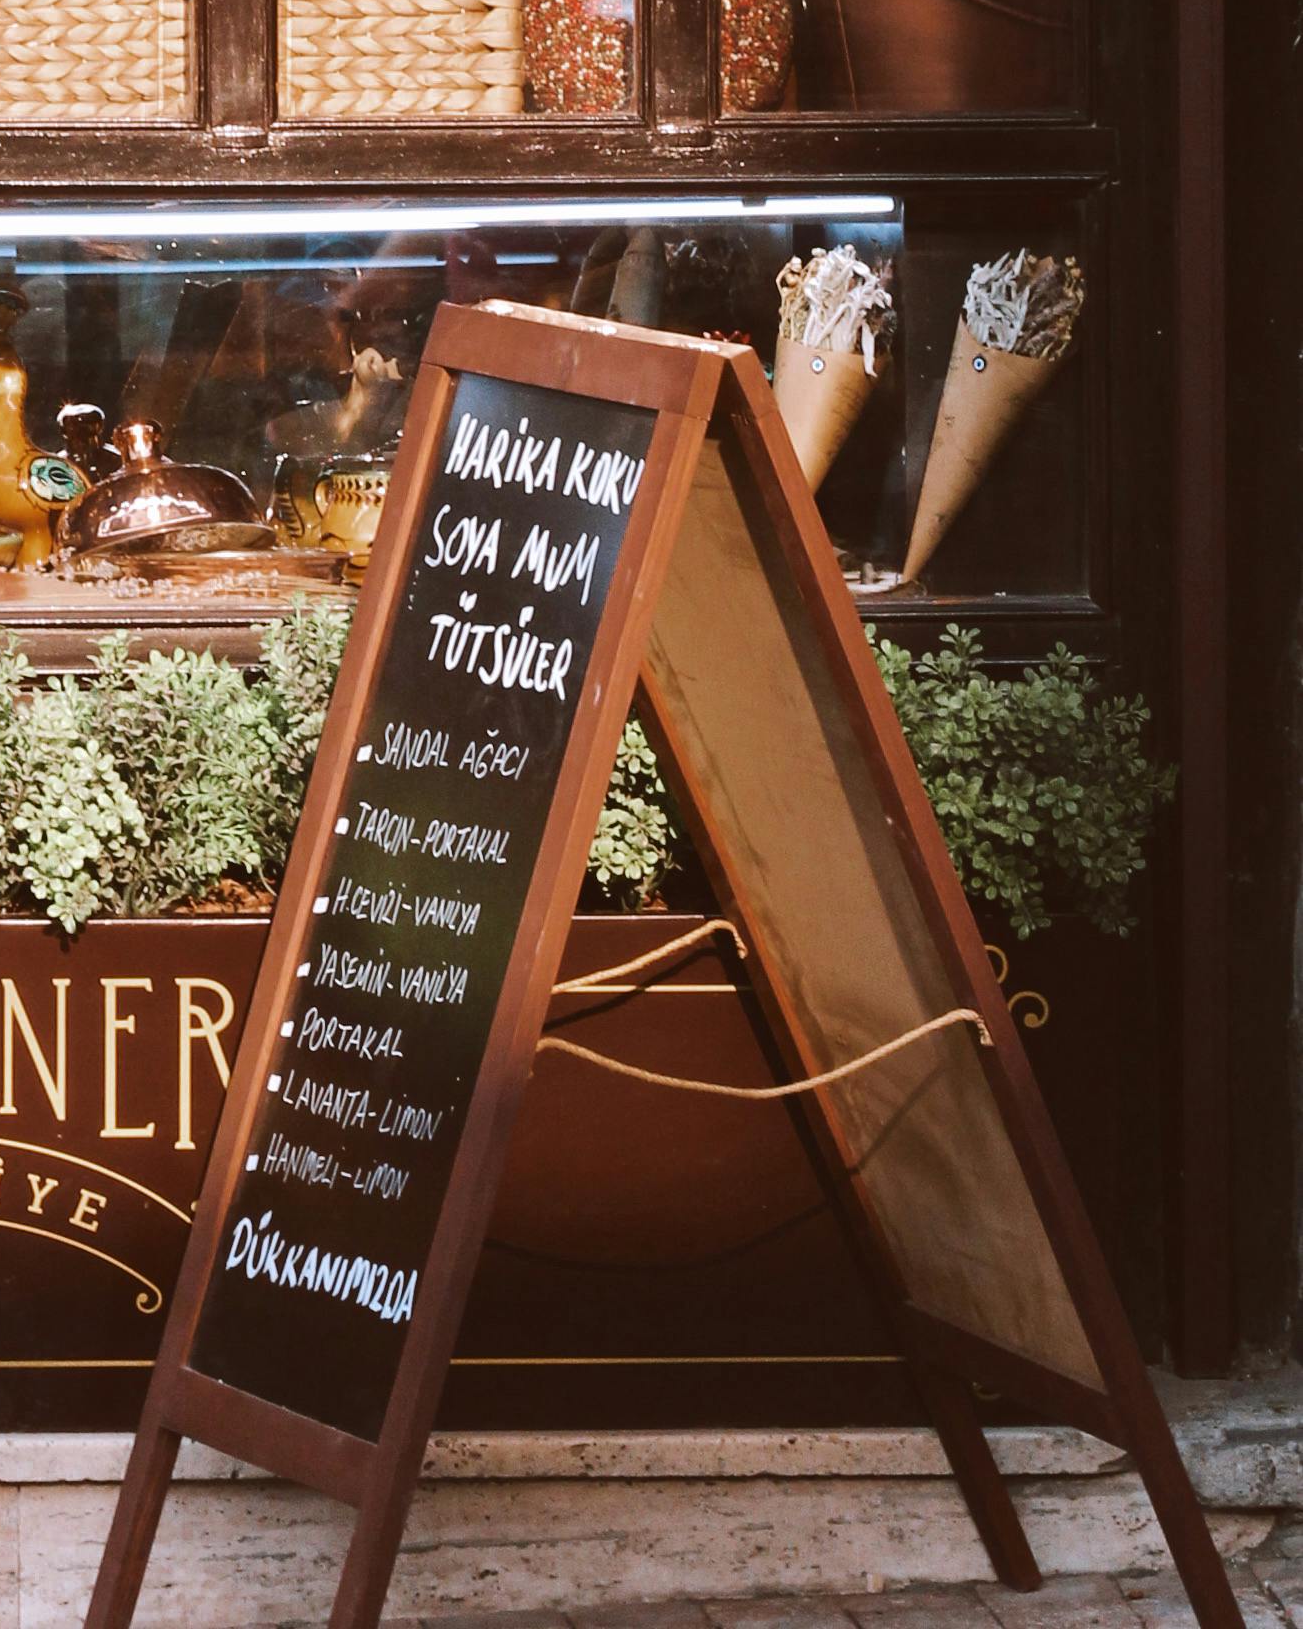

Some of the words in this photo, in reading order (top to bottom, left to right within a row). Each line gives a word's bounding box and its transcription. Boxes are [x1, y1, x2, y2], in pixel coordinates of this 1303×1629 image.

[444, 412, 557, 496] HARİKA
[563, 440, 646, 515] KOKU
[424, 503, 499, 577] SOYA
[511, 524, 599, 605] MUM
[427, 591, 574, 701] TÜTSÜLER
[375, 722, 449, 771] SANDAL
[459, 728, 530, 781] AĞACI
[296, 1006, 404, 1061] PORTAKAL
